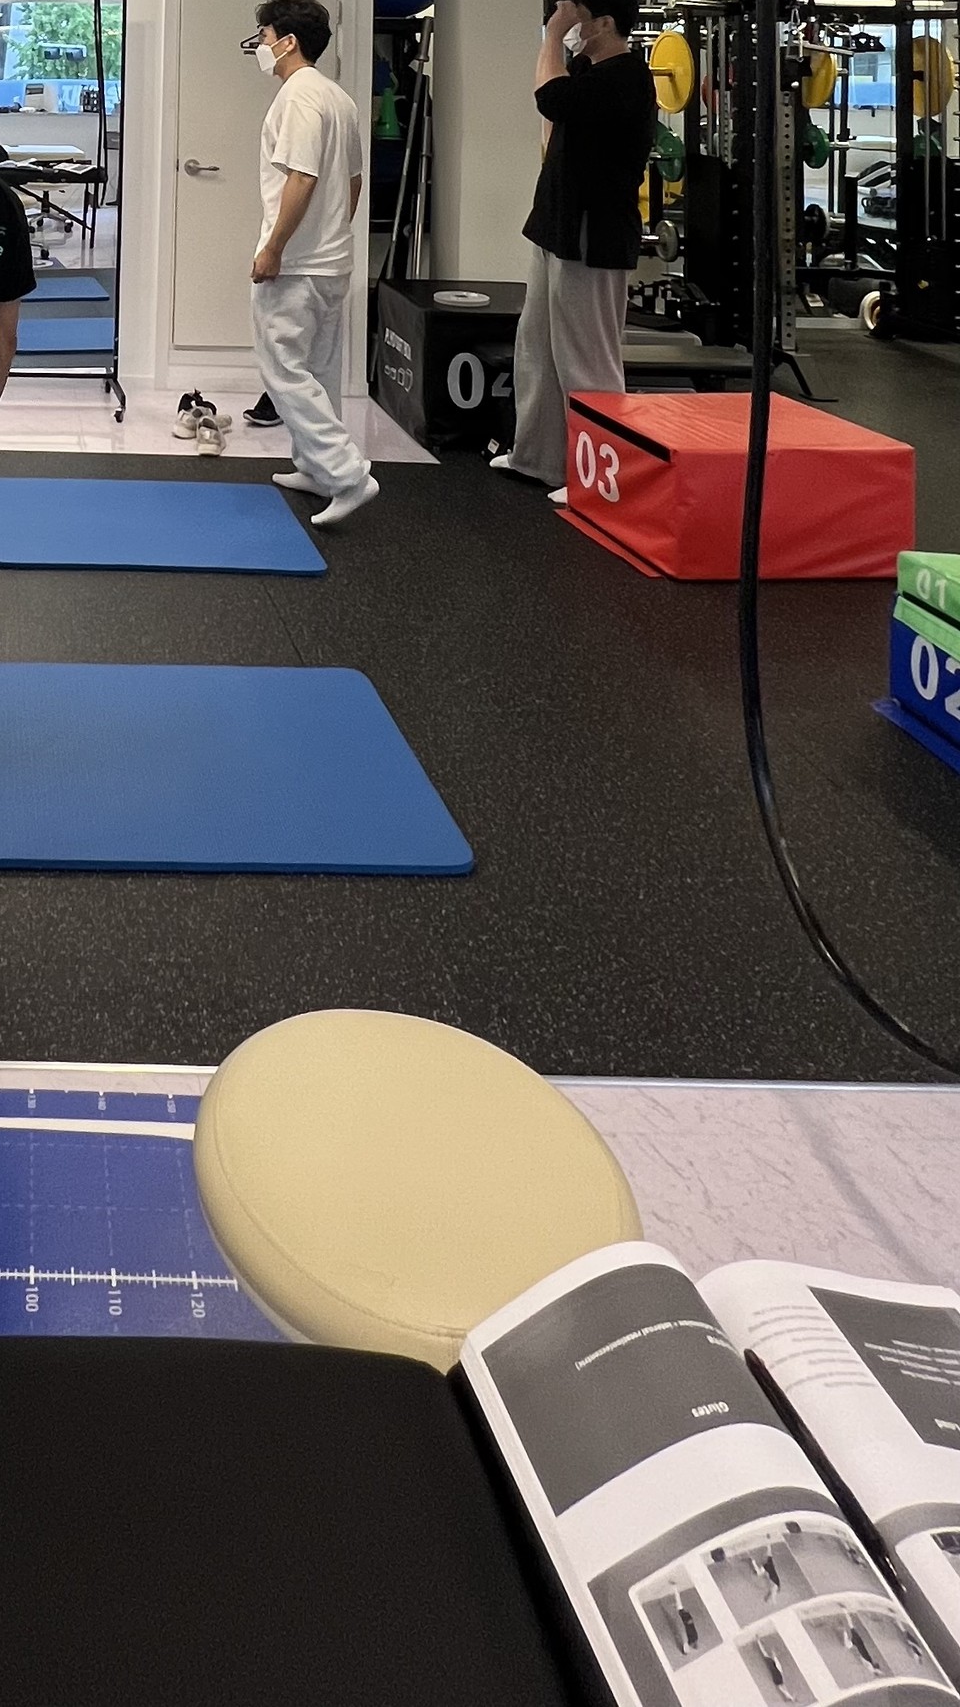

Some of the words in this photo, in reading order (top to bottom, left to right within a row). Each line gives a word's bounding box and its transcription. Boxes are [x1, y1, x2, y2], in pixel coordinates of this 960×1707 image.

[575, 430, 620, 503] 03
[916, 568, 948, 611] 01
[25, 1286, 39, 1312] 100
[108, 1290, 122, 1316] 110
[190, 1292, 205, 1318] 120
[691, 1401, 729, 1418] Glutes
